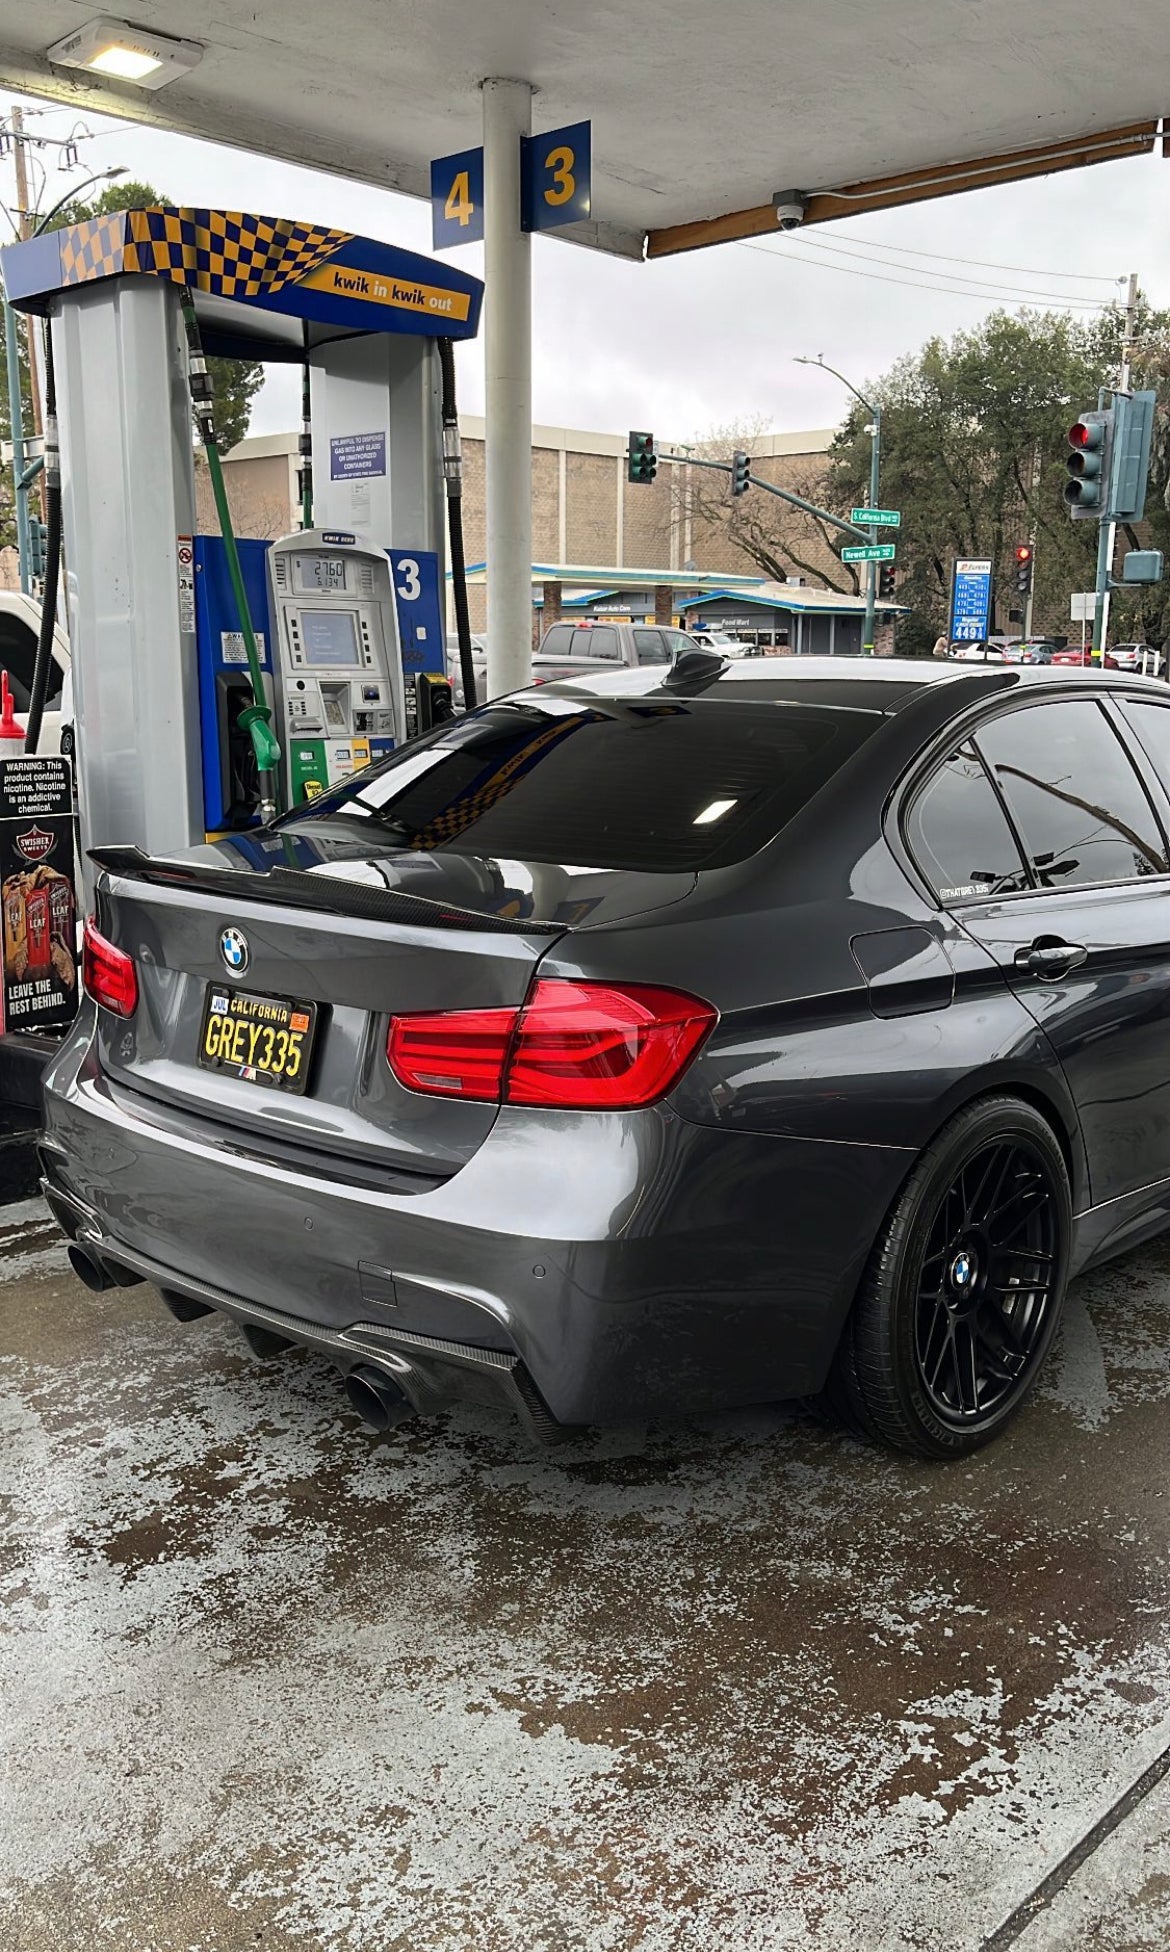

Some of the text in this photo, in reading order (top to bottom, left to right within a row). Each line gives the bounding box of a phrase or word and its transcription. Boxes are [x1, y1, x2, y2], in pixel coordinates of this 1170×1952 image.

[544, 146, 576, 206] 3
[444, 171, 474, 226] 4
[334, 272, 453, 311] kwik in kwik out
[344, 460, 371, 470] CONTAINERS
[845, 550, 866, 559] Newell
[867, 549, 880, 557] Ave
[397, 558, 421, 600] 3
[721, 618, 750, 626] Food Mart
[6, 760, 63, 772] WARNING: This
[4, 771, 65, 784] product contains
[3, 782, 66, 793] nicotine. Nicotine
[306, 783, 321, 791] Diesel
[8, 791, 61, 804] is an addictive
[18, 802, 53, 814] chemical.
[20, 837, 50, 847] SWISHER
[52, 905, 69, 916] LEAF
[29, 918, 46, 929] LEAF
[9, 979, 52, 1000] LEAVE THE
[9, 991, 66, 1016] REST BEHIND.
[213, 997, 227, 1012] JUL
[230, 999, 288, 1023] CALIFORNIA
[205, 1014, 302, 1076] GREY335
